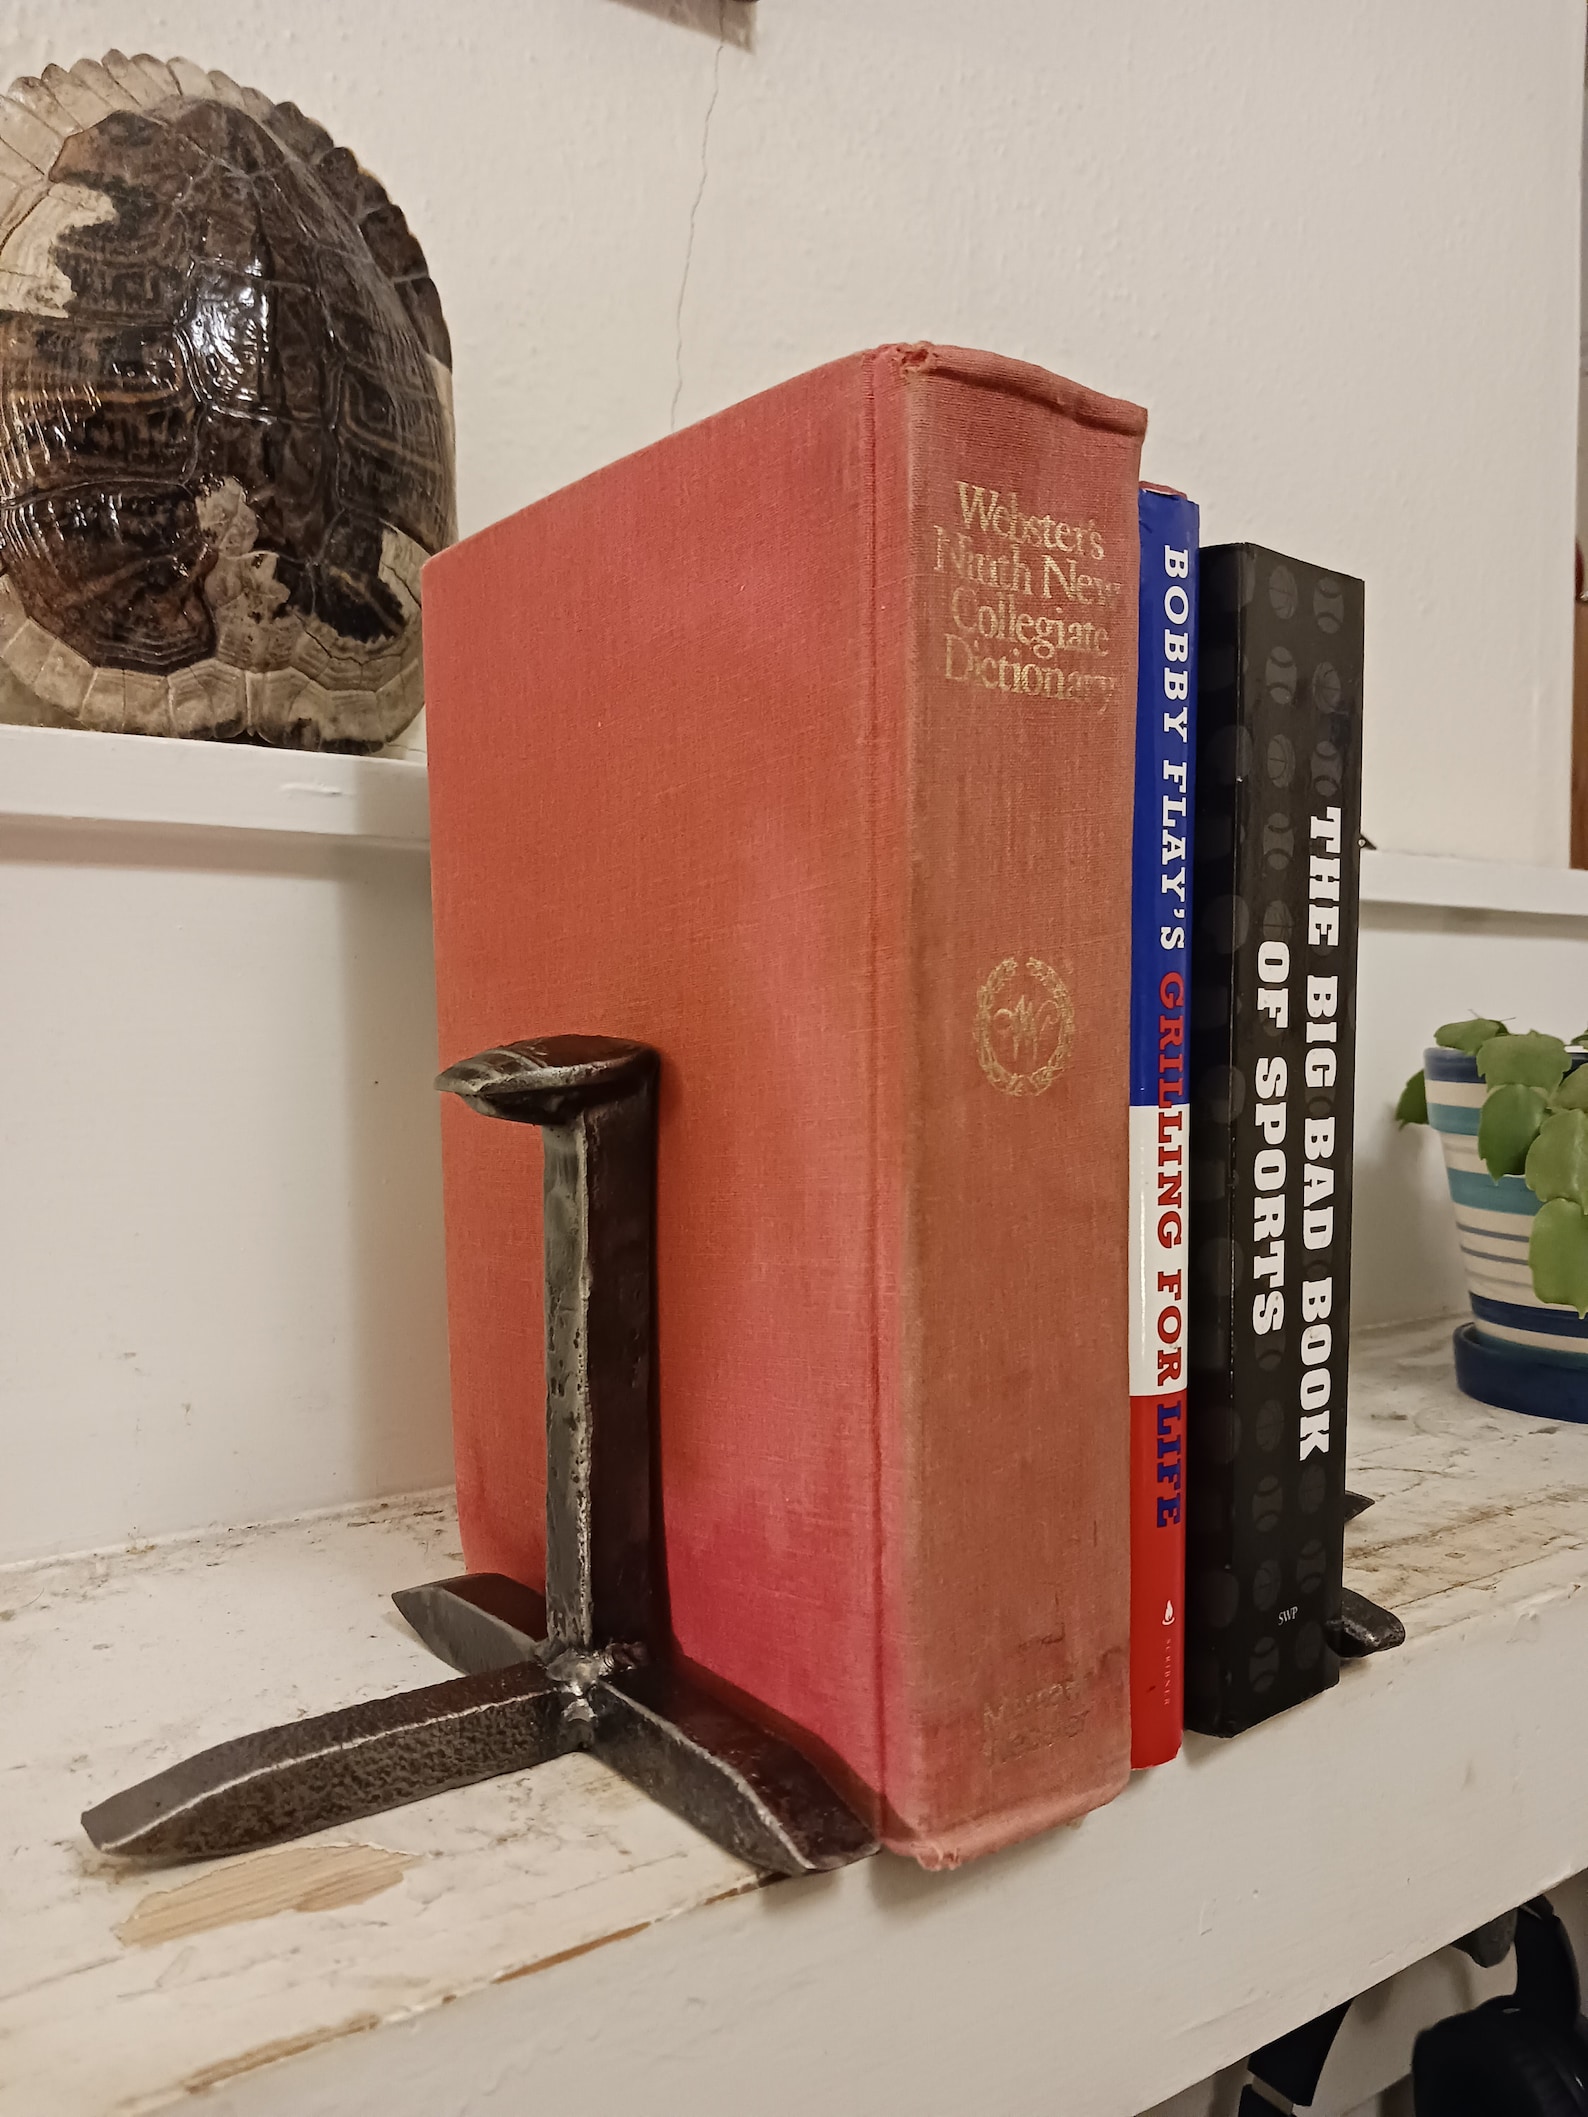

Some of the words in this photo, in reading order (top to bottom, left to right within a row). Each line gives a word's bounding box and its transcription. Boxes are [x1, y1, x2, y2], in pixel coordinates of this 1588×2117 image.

[1163, 543, 1189, 744] BOBBY
[1160, 759, 1187, 951] FLAY'S
[1307, 806, 1342, 946] THE
[1257, 940, 1291, 1029] OF
[1304, 974, 1339, 1088] BIG
[1157, 971, 1184, 1250] GRILLING
[1252, 1056, 1288, 1336] SPORTS
[1302, 1116, 1336, 1251] BAD
[1157, 1269, 1182, 1386] FOR
[1299, 1276, 1333, 1463] BOOK
[1157, 1401, 1181, 1528] LIFE
